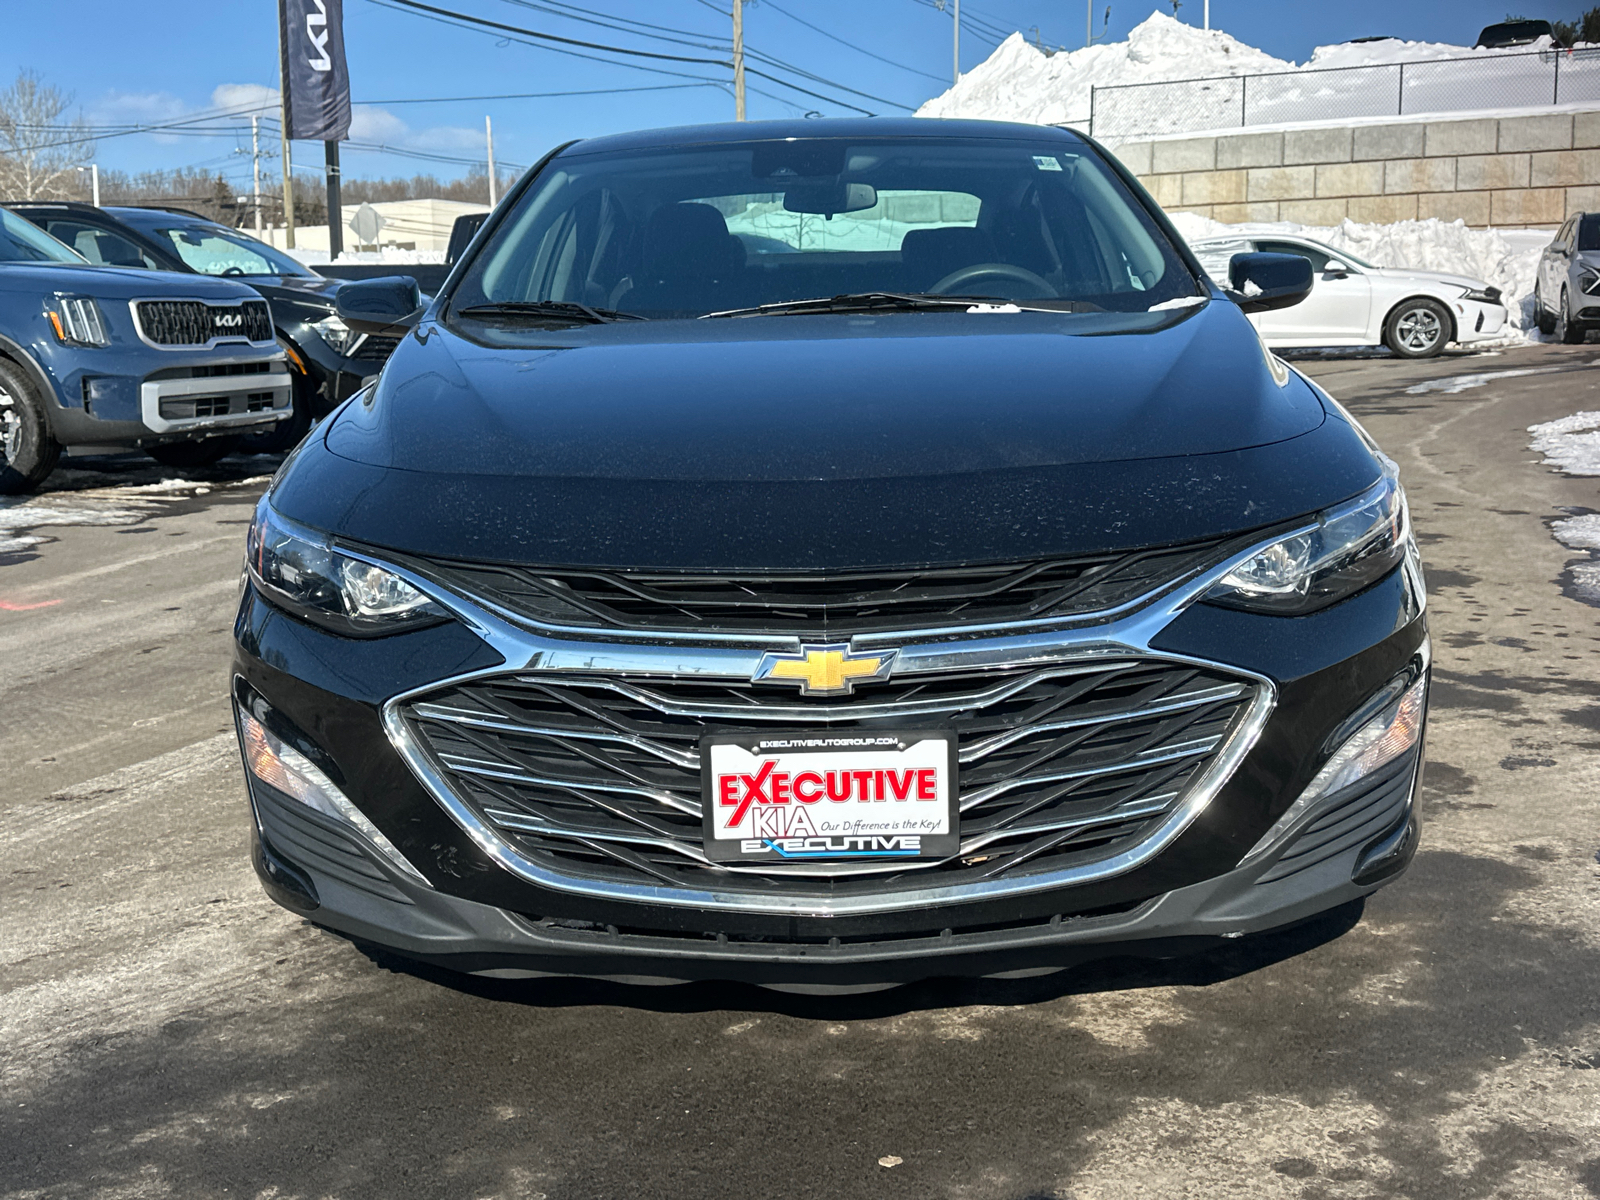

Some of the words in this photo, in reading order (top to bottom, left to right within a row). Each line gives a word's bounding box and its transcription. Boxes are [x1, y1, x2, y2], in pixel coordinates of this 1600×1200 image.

[759, 737, 899, 749] EXECUTIVEAUTOGROUP.COM
[718, 758, 938, 828] EXECUTIVE
[752, 805, 819, 838] KIA
[820, 821, 840, 831] Our
[842, 819, 890, 835] Difference
[891, 820, 900, 829] is
[902, 819, 918, 829] the
[919, 818, 942, 833] Key!
[740, 836, 921, 855] EXECUTIVE
